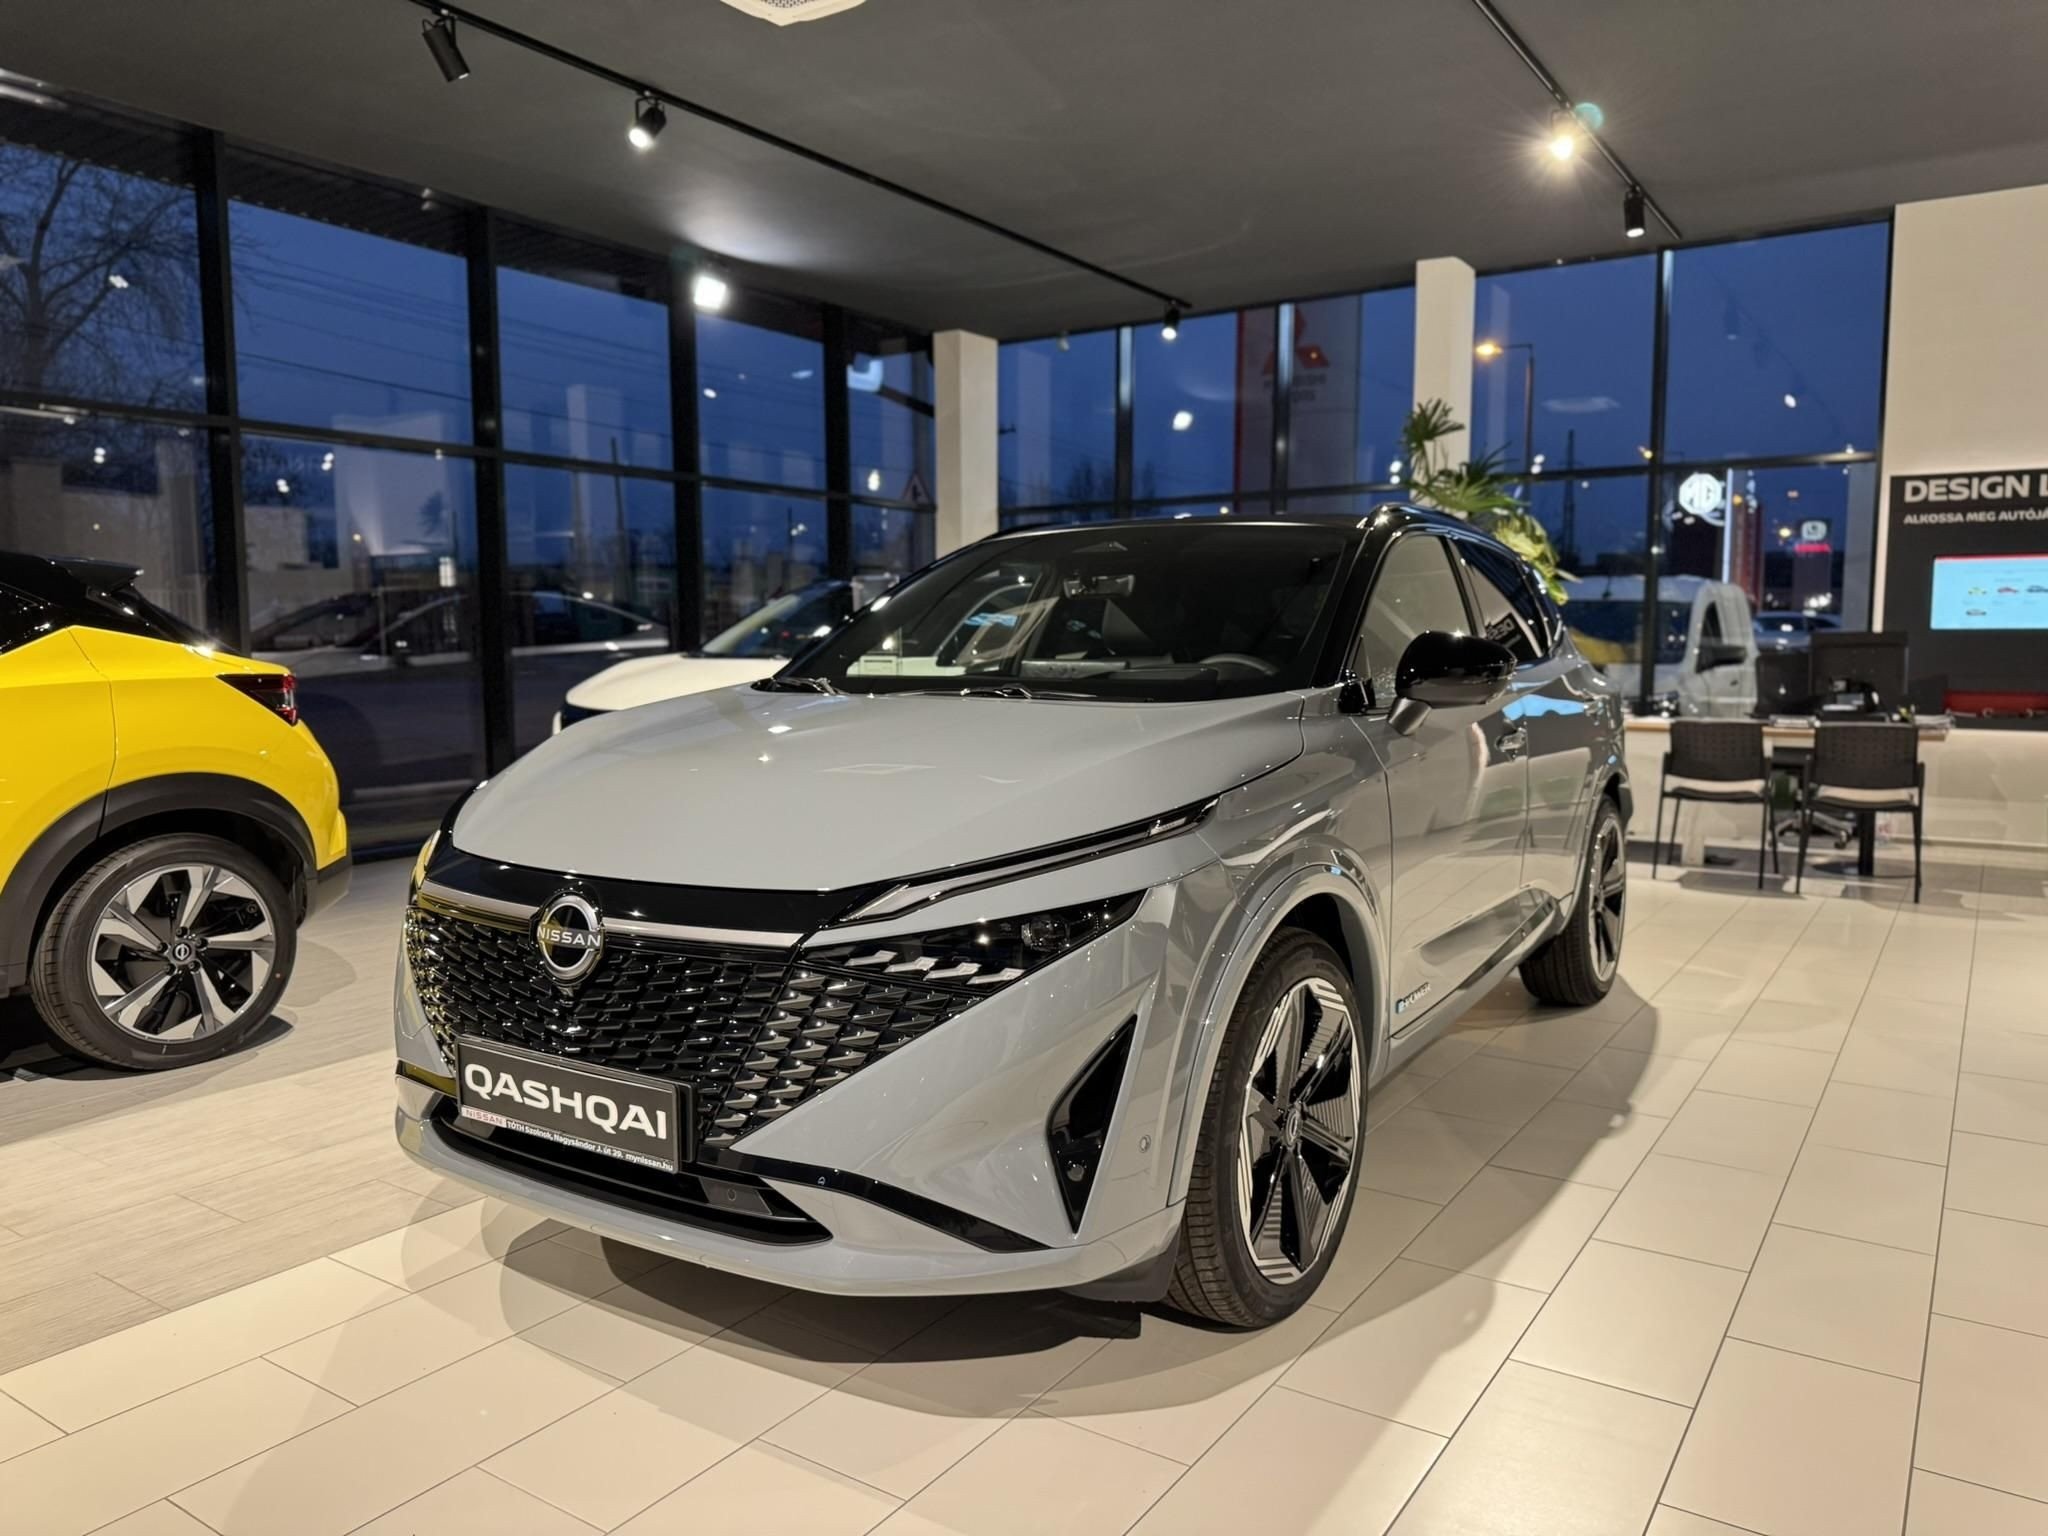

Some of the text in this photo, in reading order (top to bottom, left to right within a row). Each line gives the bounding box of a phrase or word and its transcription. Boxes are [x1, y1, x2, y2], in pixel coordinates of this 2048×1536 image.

[1904, 474, 2031, 503] DESIGN
[1903, 512, 1964, 525] ALKOSSA
[1966, 511, 1996, 523] MEG
[537, 926, 601, 947] NISSAN
[464, 1063, 667, 1140] QASHQAI
[465, 1109, 504, 1125] NISSAN
[507, 1120, 525, 1133] TÓTH
[625, 1153, 674, 1172] mynissan.hu
